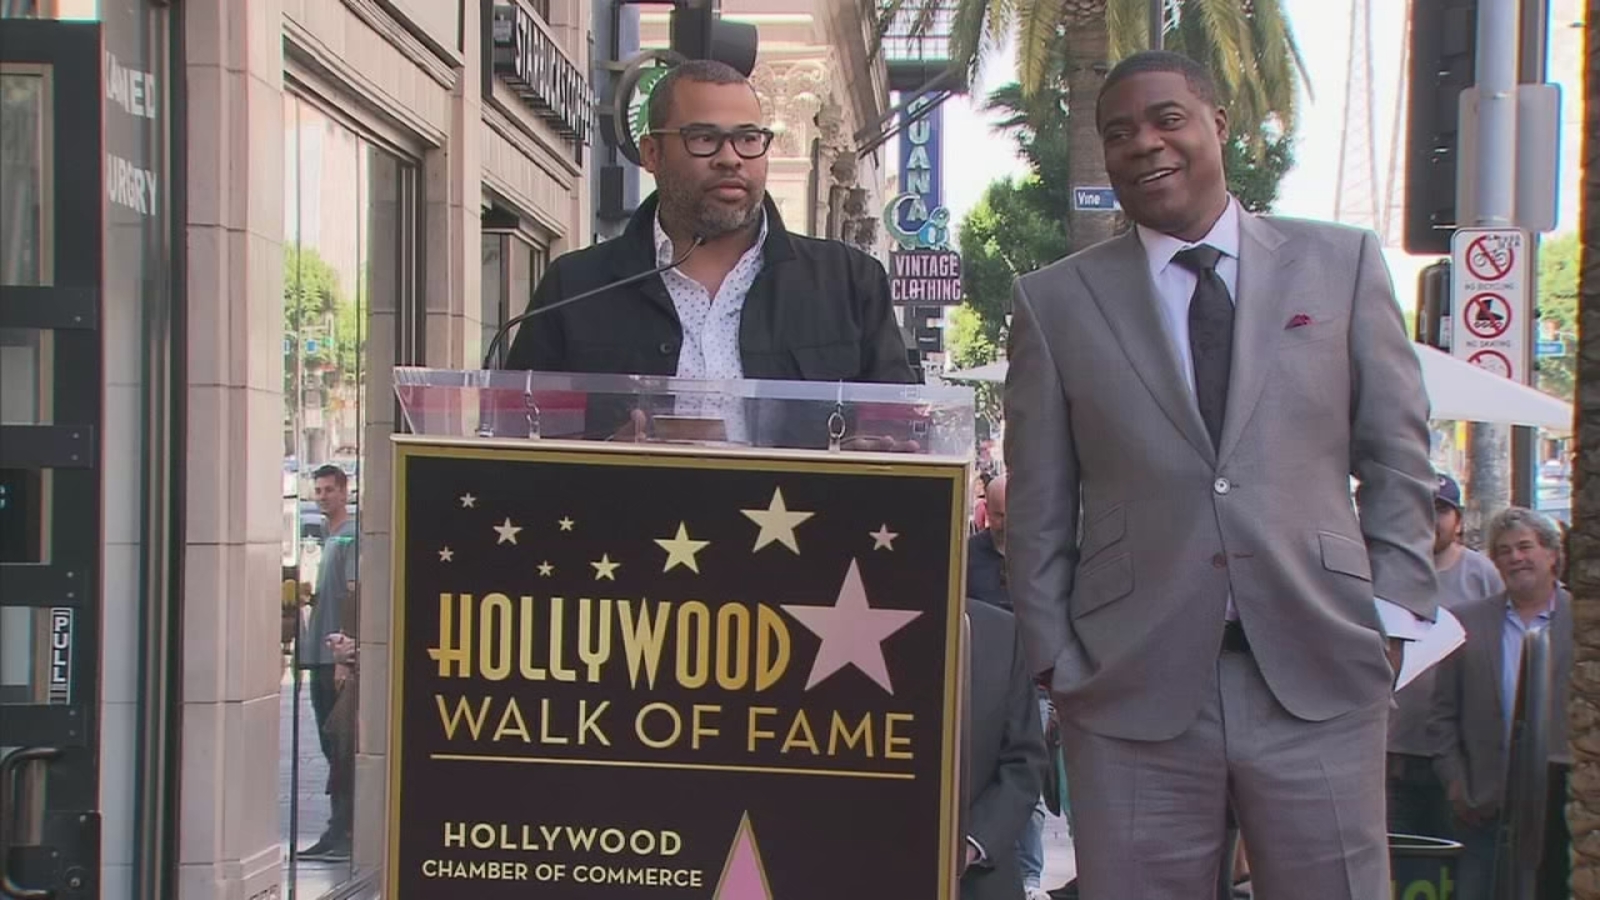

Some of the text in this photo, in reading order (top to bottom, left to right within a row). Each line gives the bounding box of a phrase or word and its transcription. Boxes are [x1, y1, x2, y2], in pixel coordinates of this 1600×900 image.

[1078, 191, 1101, 206] Vine
[894, 254, 959, 277] VINTAGE
[891, 278, 961, 301] CLOTHING
[53, 617, 69, 682] PULL
[427, 593, 791, 692] HOLLYWOOD
[435, 695, 914, 759] WALK OF FAME
[444, 822, 682, 855] HOLLYWOOD
[422, 860, 703, 888] CHAMBER OF COMMERCE
